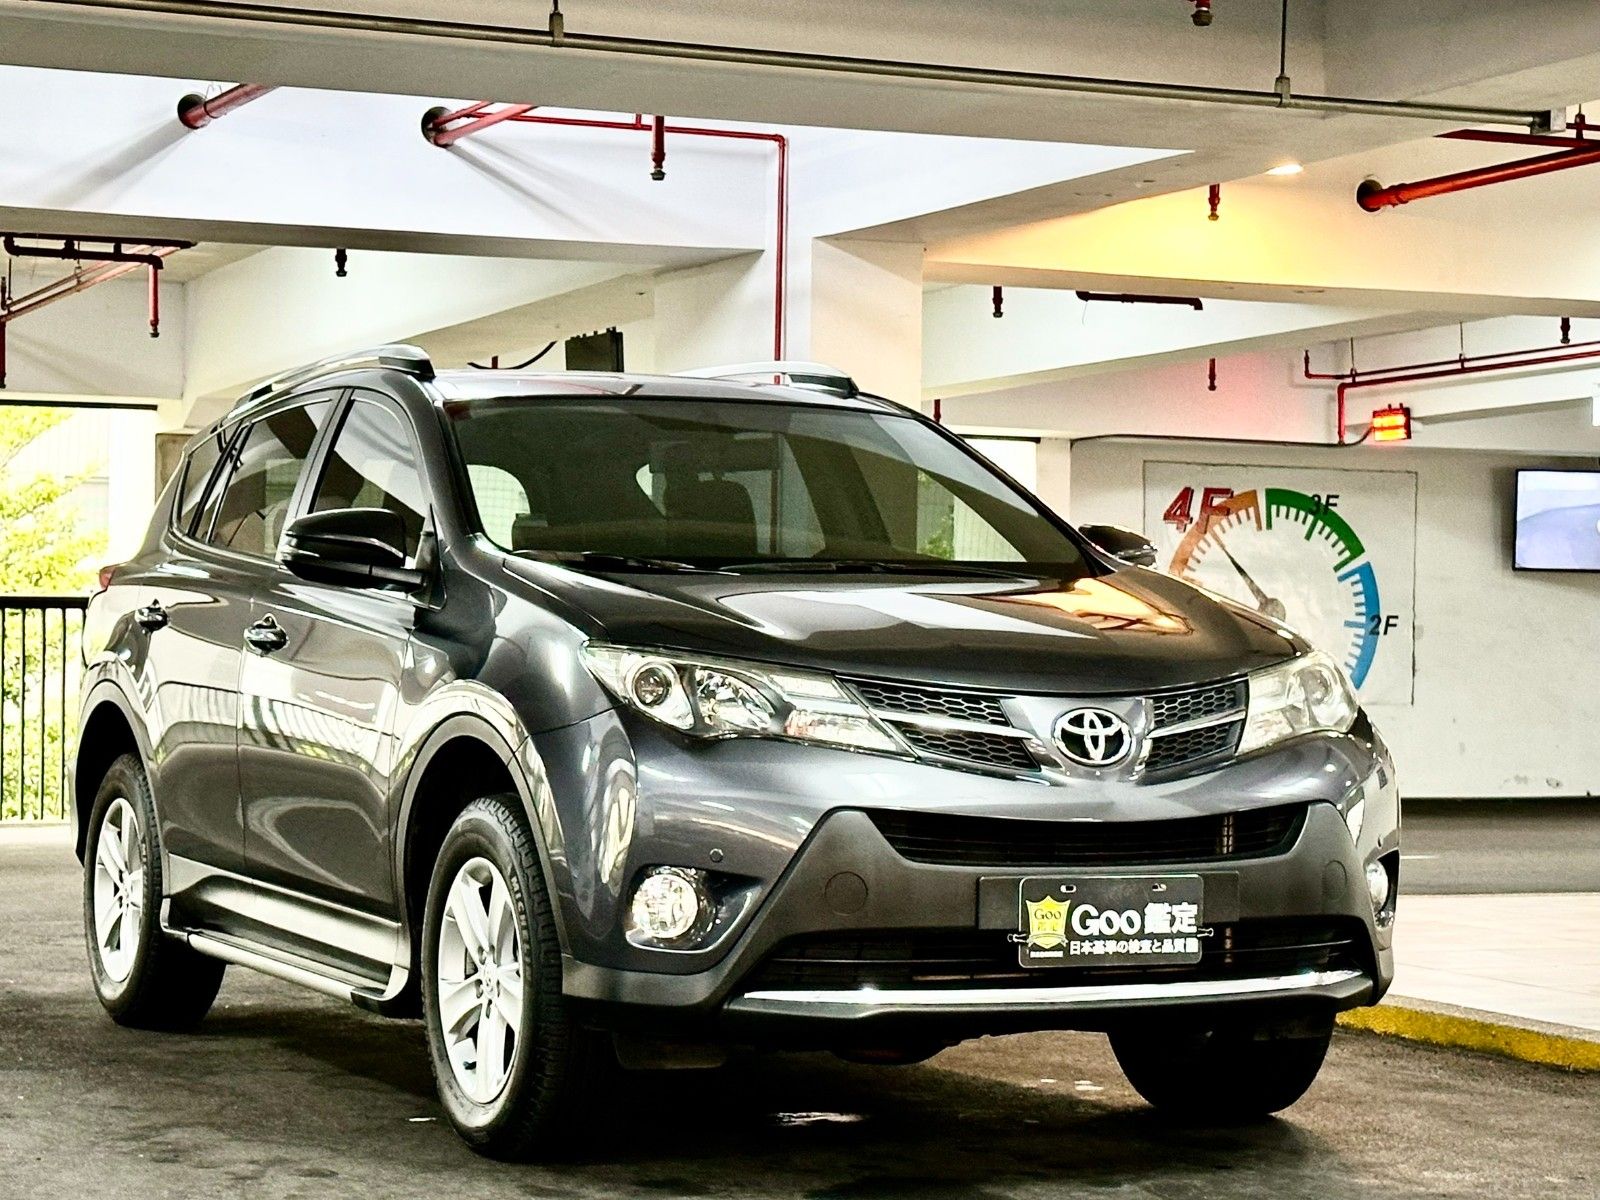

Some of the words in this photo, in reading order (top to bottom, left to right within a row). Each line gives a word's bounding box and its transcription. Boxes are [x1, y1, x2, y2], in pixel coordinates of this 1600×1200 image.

[1163, 486, 1234, 533] 4F
[1310, 494, 1339, 516] 3F
[1369, 615, 1398, 635] 2F
[1034, 908, 1062, 920] Goo
